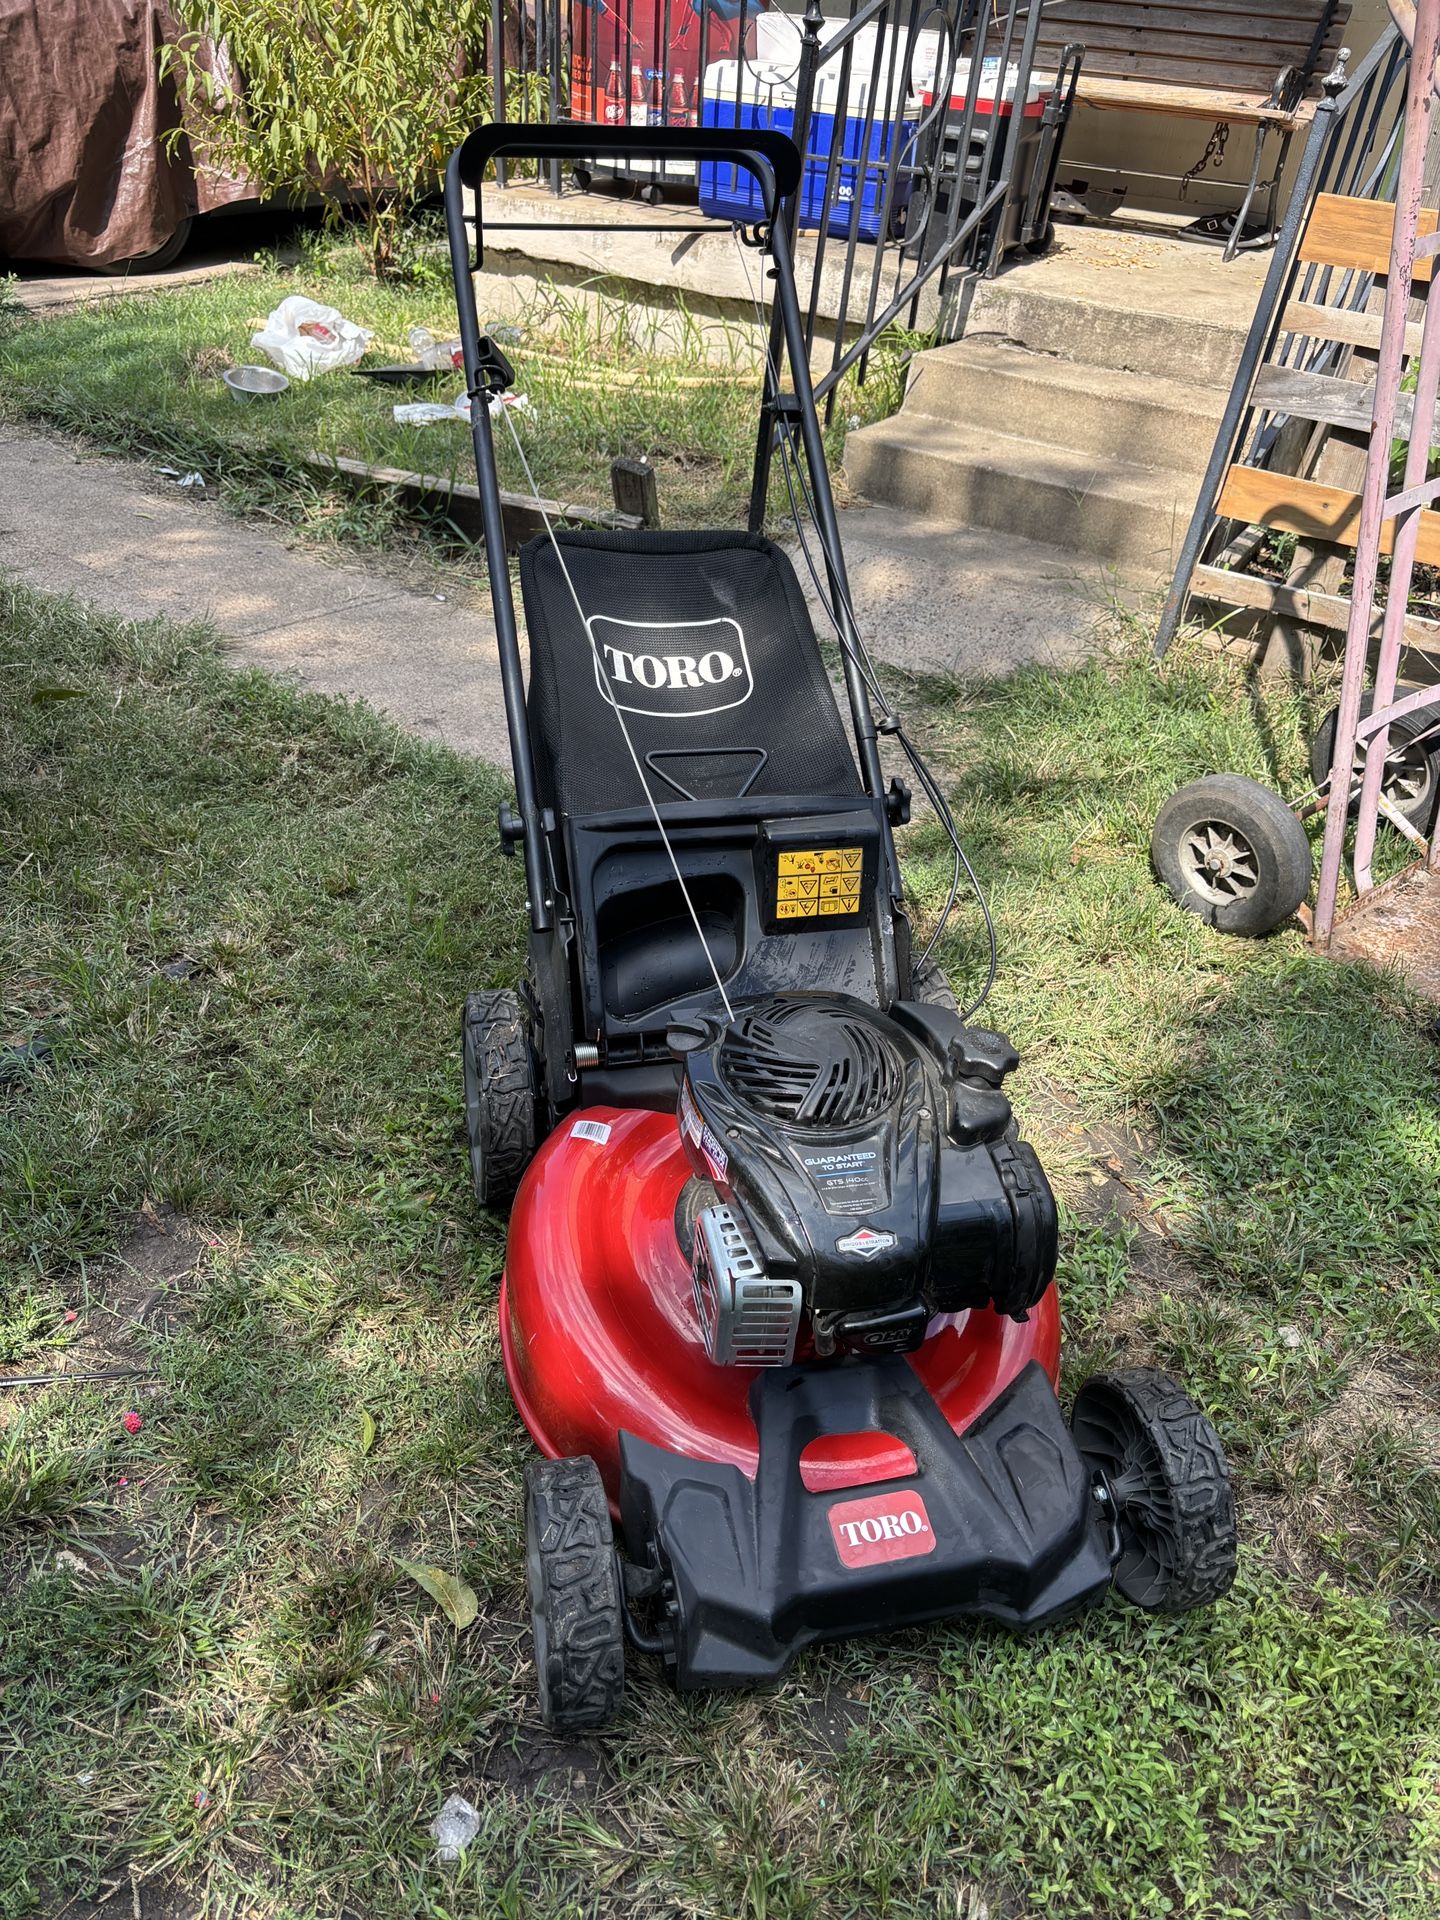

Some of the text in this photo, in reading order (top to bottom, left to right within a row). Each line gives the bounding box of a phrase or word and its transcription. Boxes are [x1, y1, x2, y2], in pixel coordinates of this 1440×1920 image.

[603, 643, 734, 689] TORO
[804, 1151, 877, 1166] GUARANTEED
[835, 1161, 864, 1170] START
[826, 1178, 844, 1186] GTS
[838, 1510, 922, 1547] TORO
